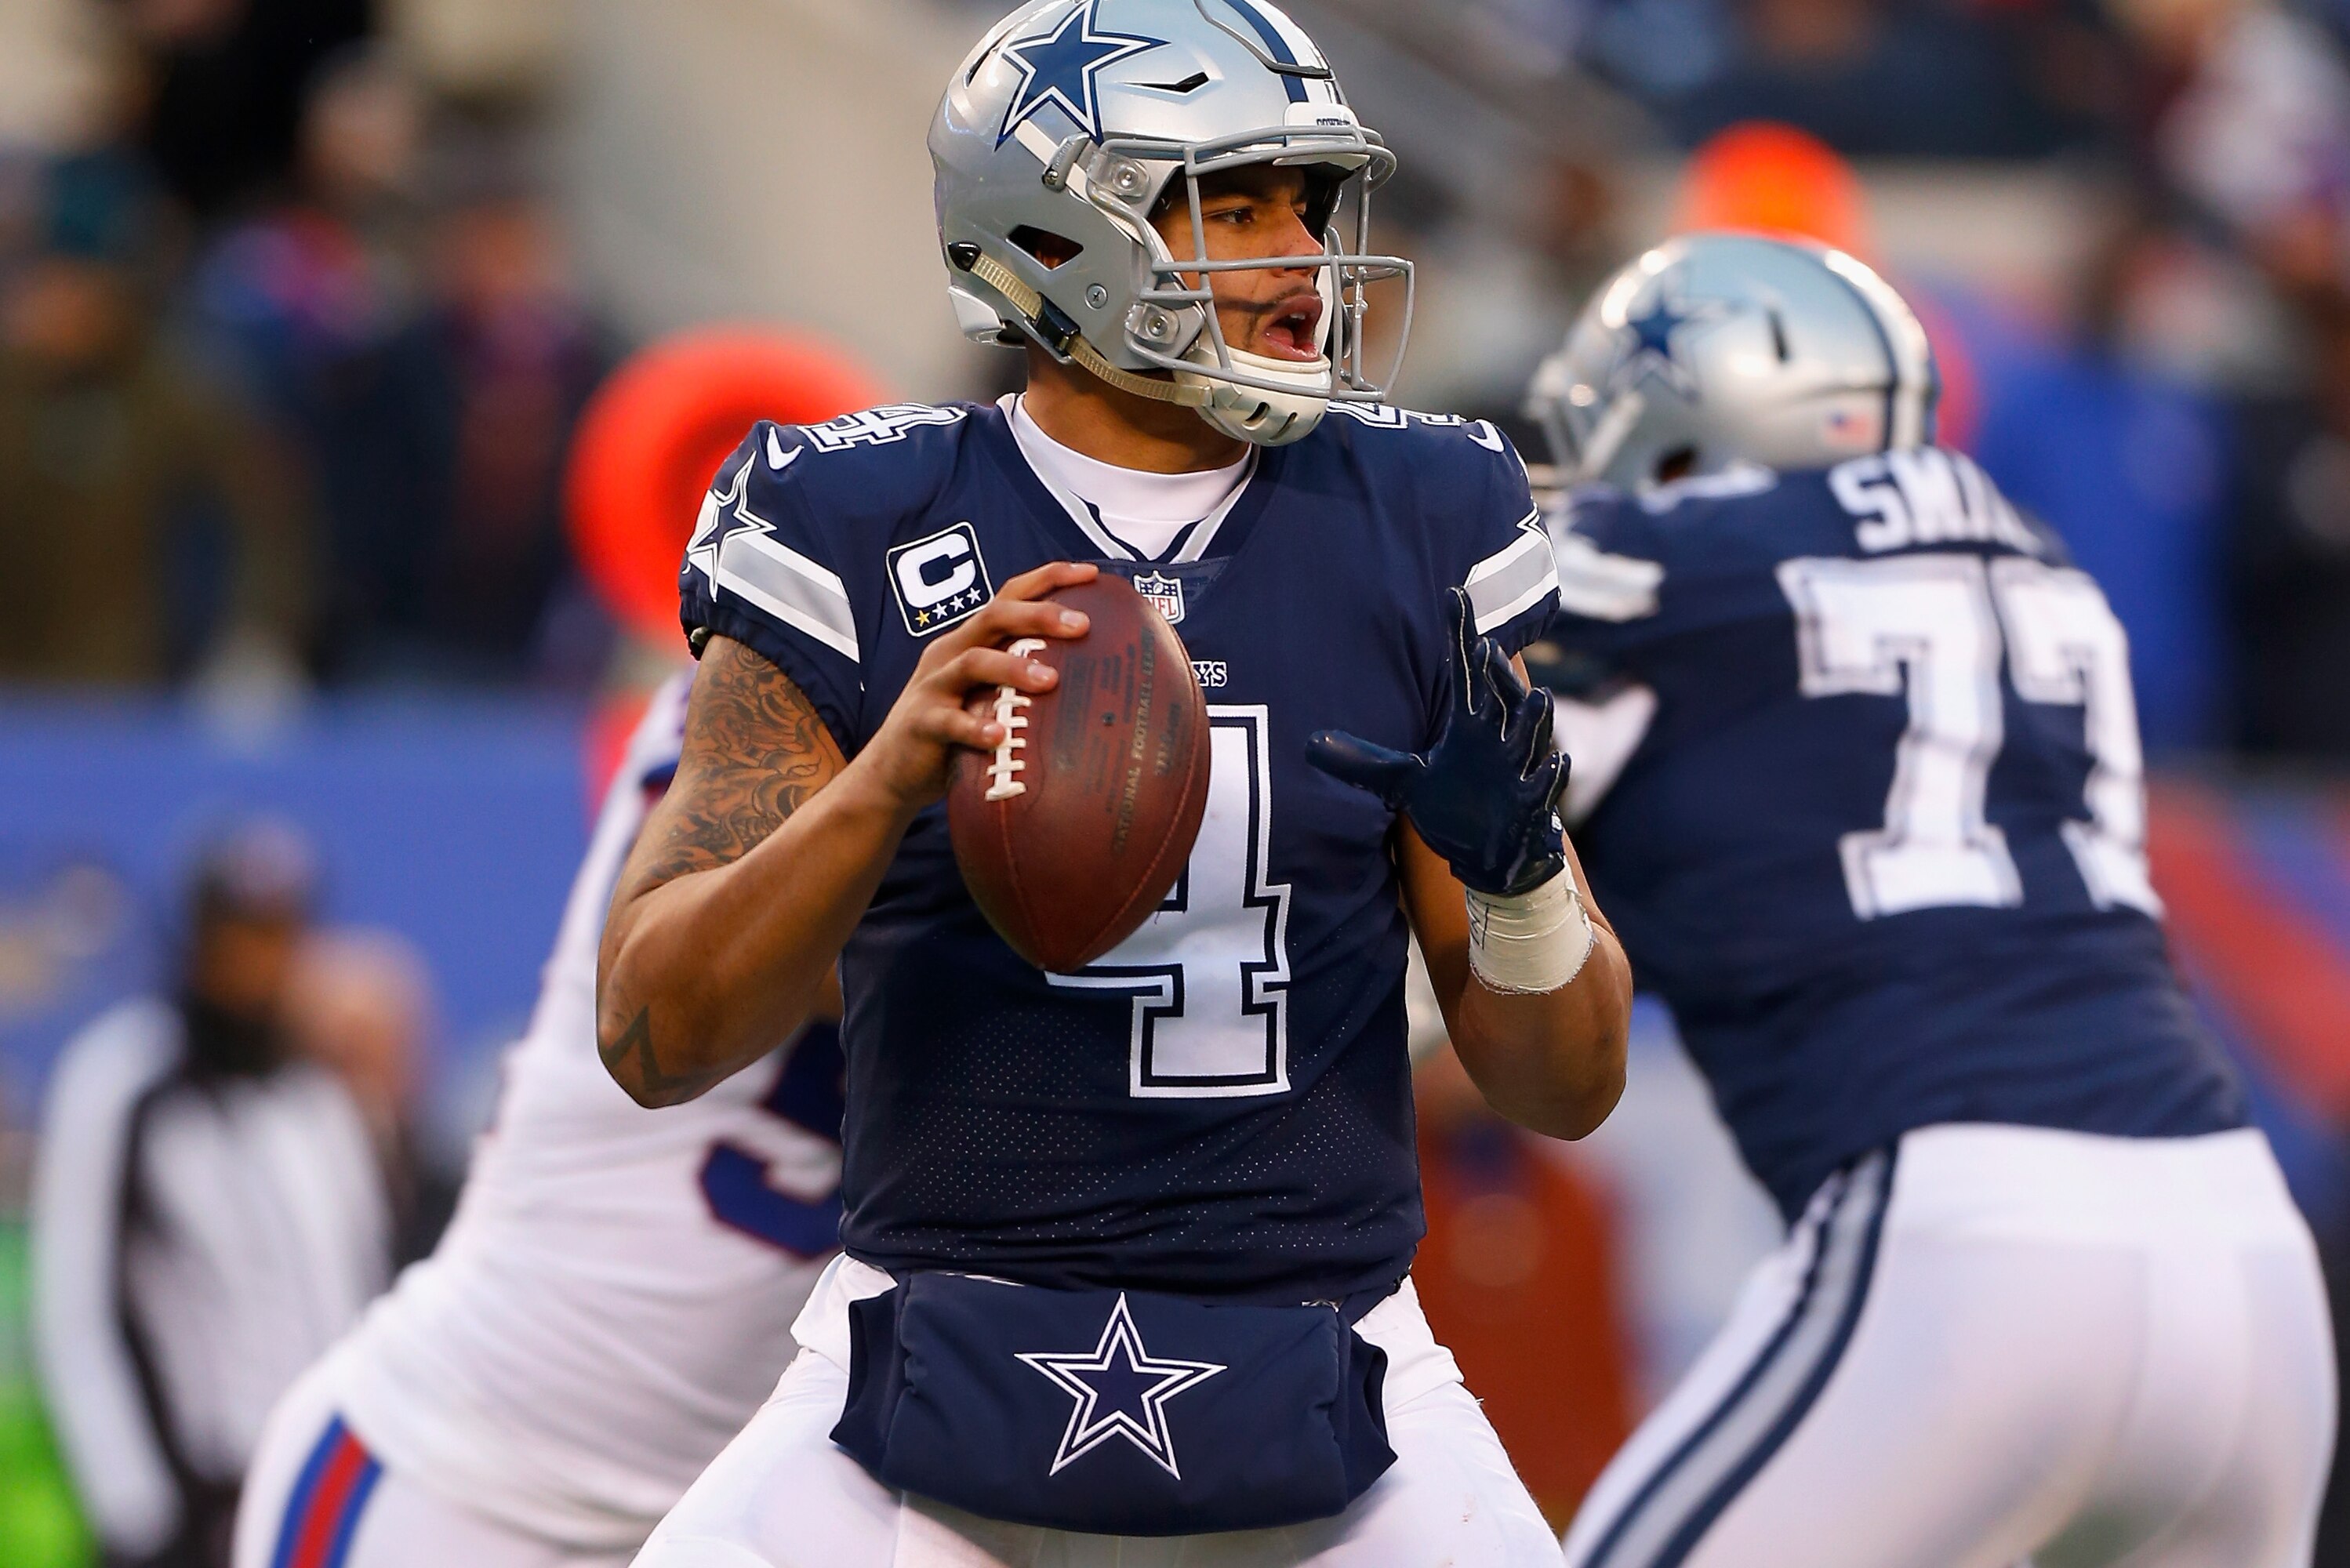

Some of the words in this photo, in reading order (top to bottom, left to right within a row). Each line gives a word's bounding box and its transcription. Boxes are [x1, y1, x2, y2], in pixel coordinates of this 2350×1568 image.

[796, 402, 968, 454] 4
[1827, 444, 2042, 552] SMI
[895, 532, 977, 609] C
[1775, 554, 2166, 920] 77
[1044, 703, 1292, 1098] 4
